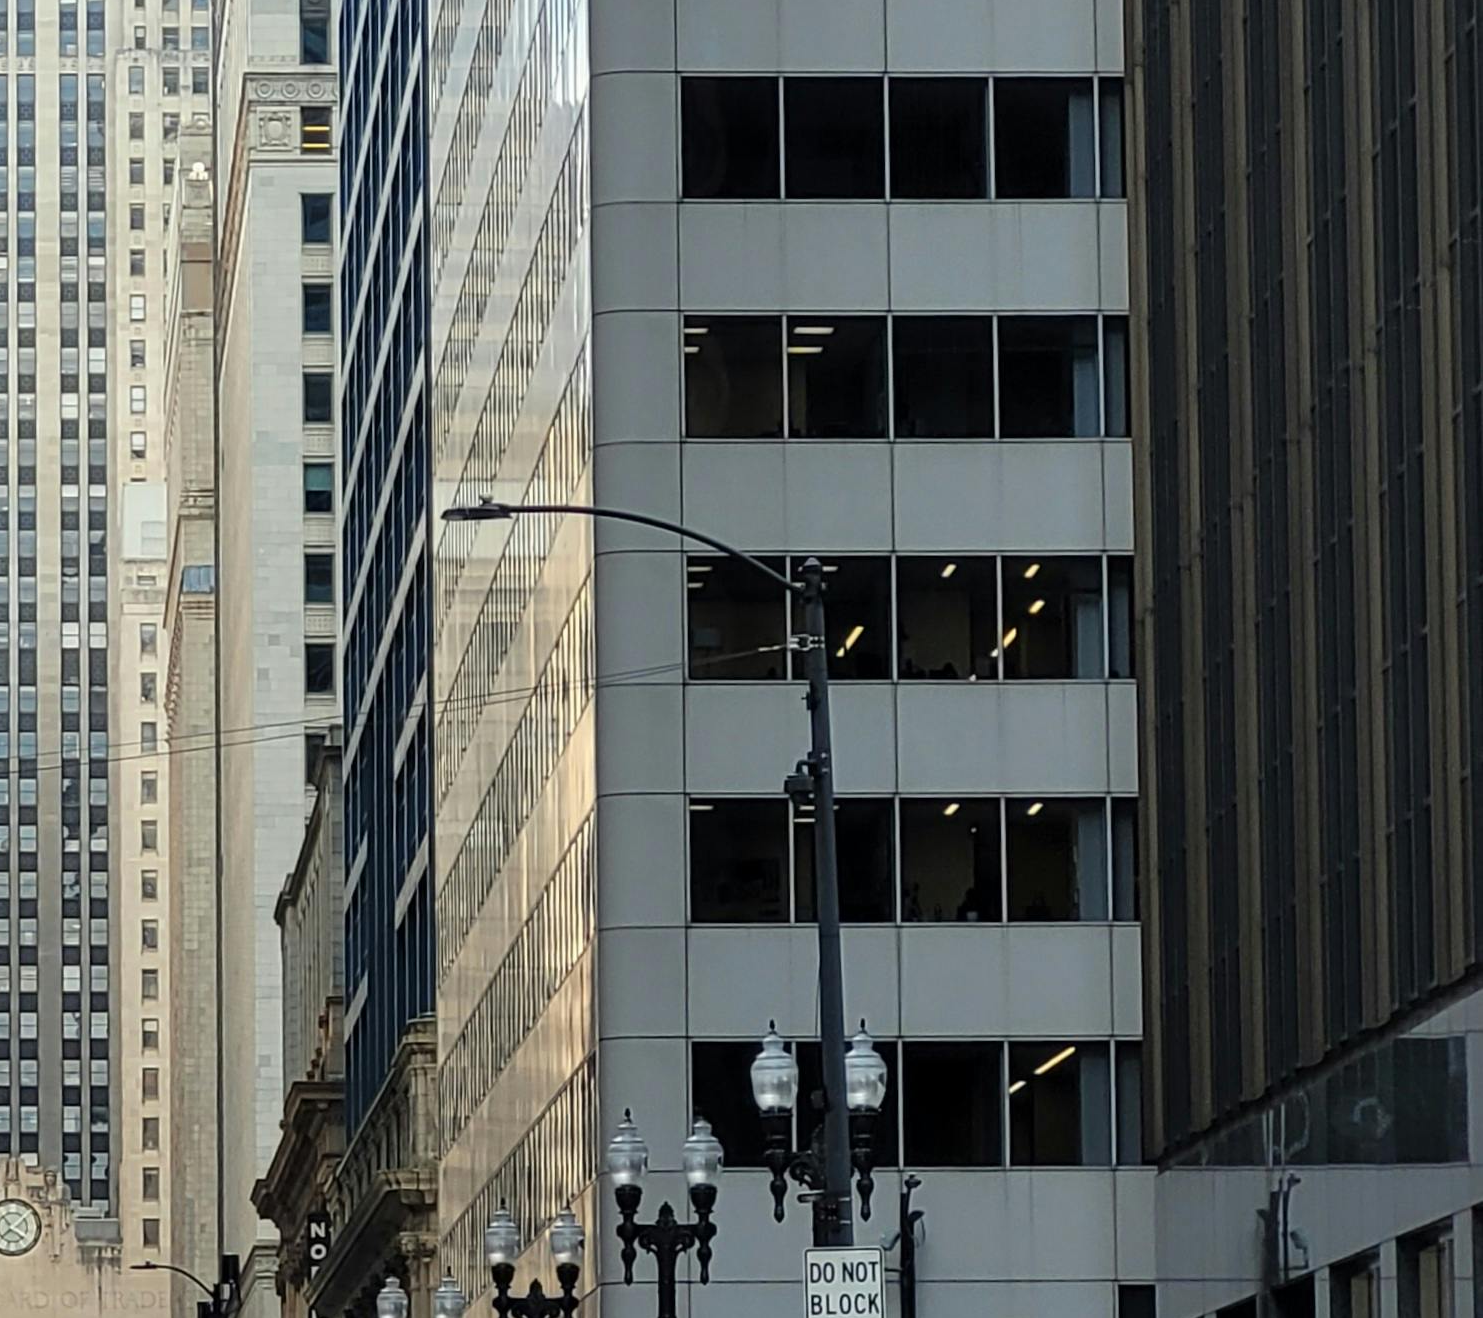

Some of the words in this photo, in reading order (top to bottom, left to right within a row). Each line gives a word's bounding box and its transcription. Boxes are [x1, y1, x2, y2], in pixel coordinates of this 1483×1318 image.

[810, 1262, 835, 1283] DO
[842, 1261, 879, 1283] NOT
[61, 1290, 89, 1309] OF
[101, 1290, 168, 1310] TRADE
[811, 1293, 880, 1315] BLOCK
